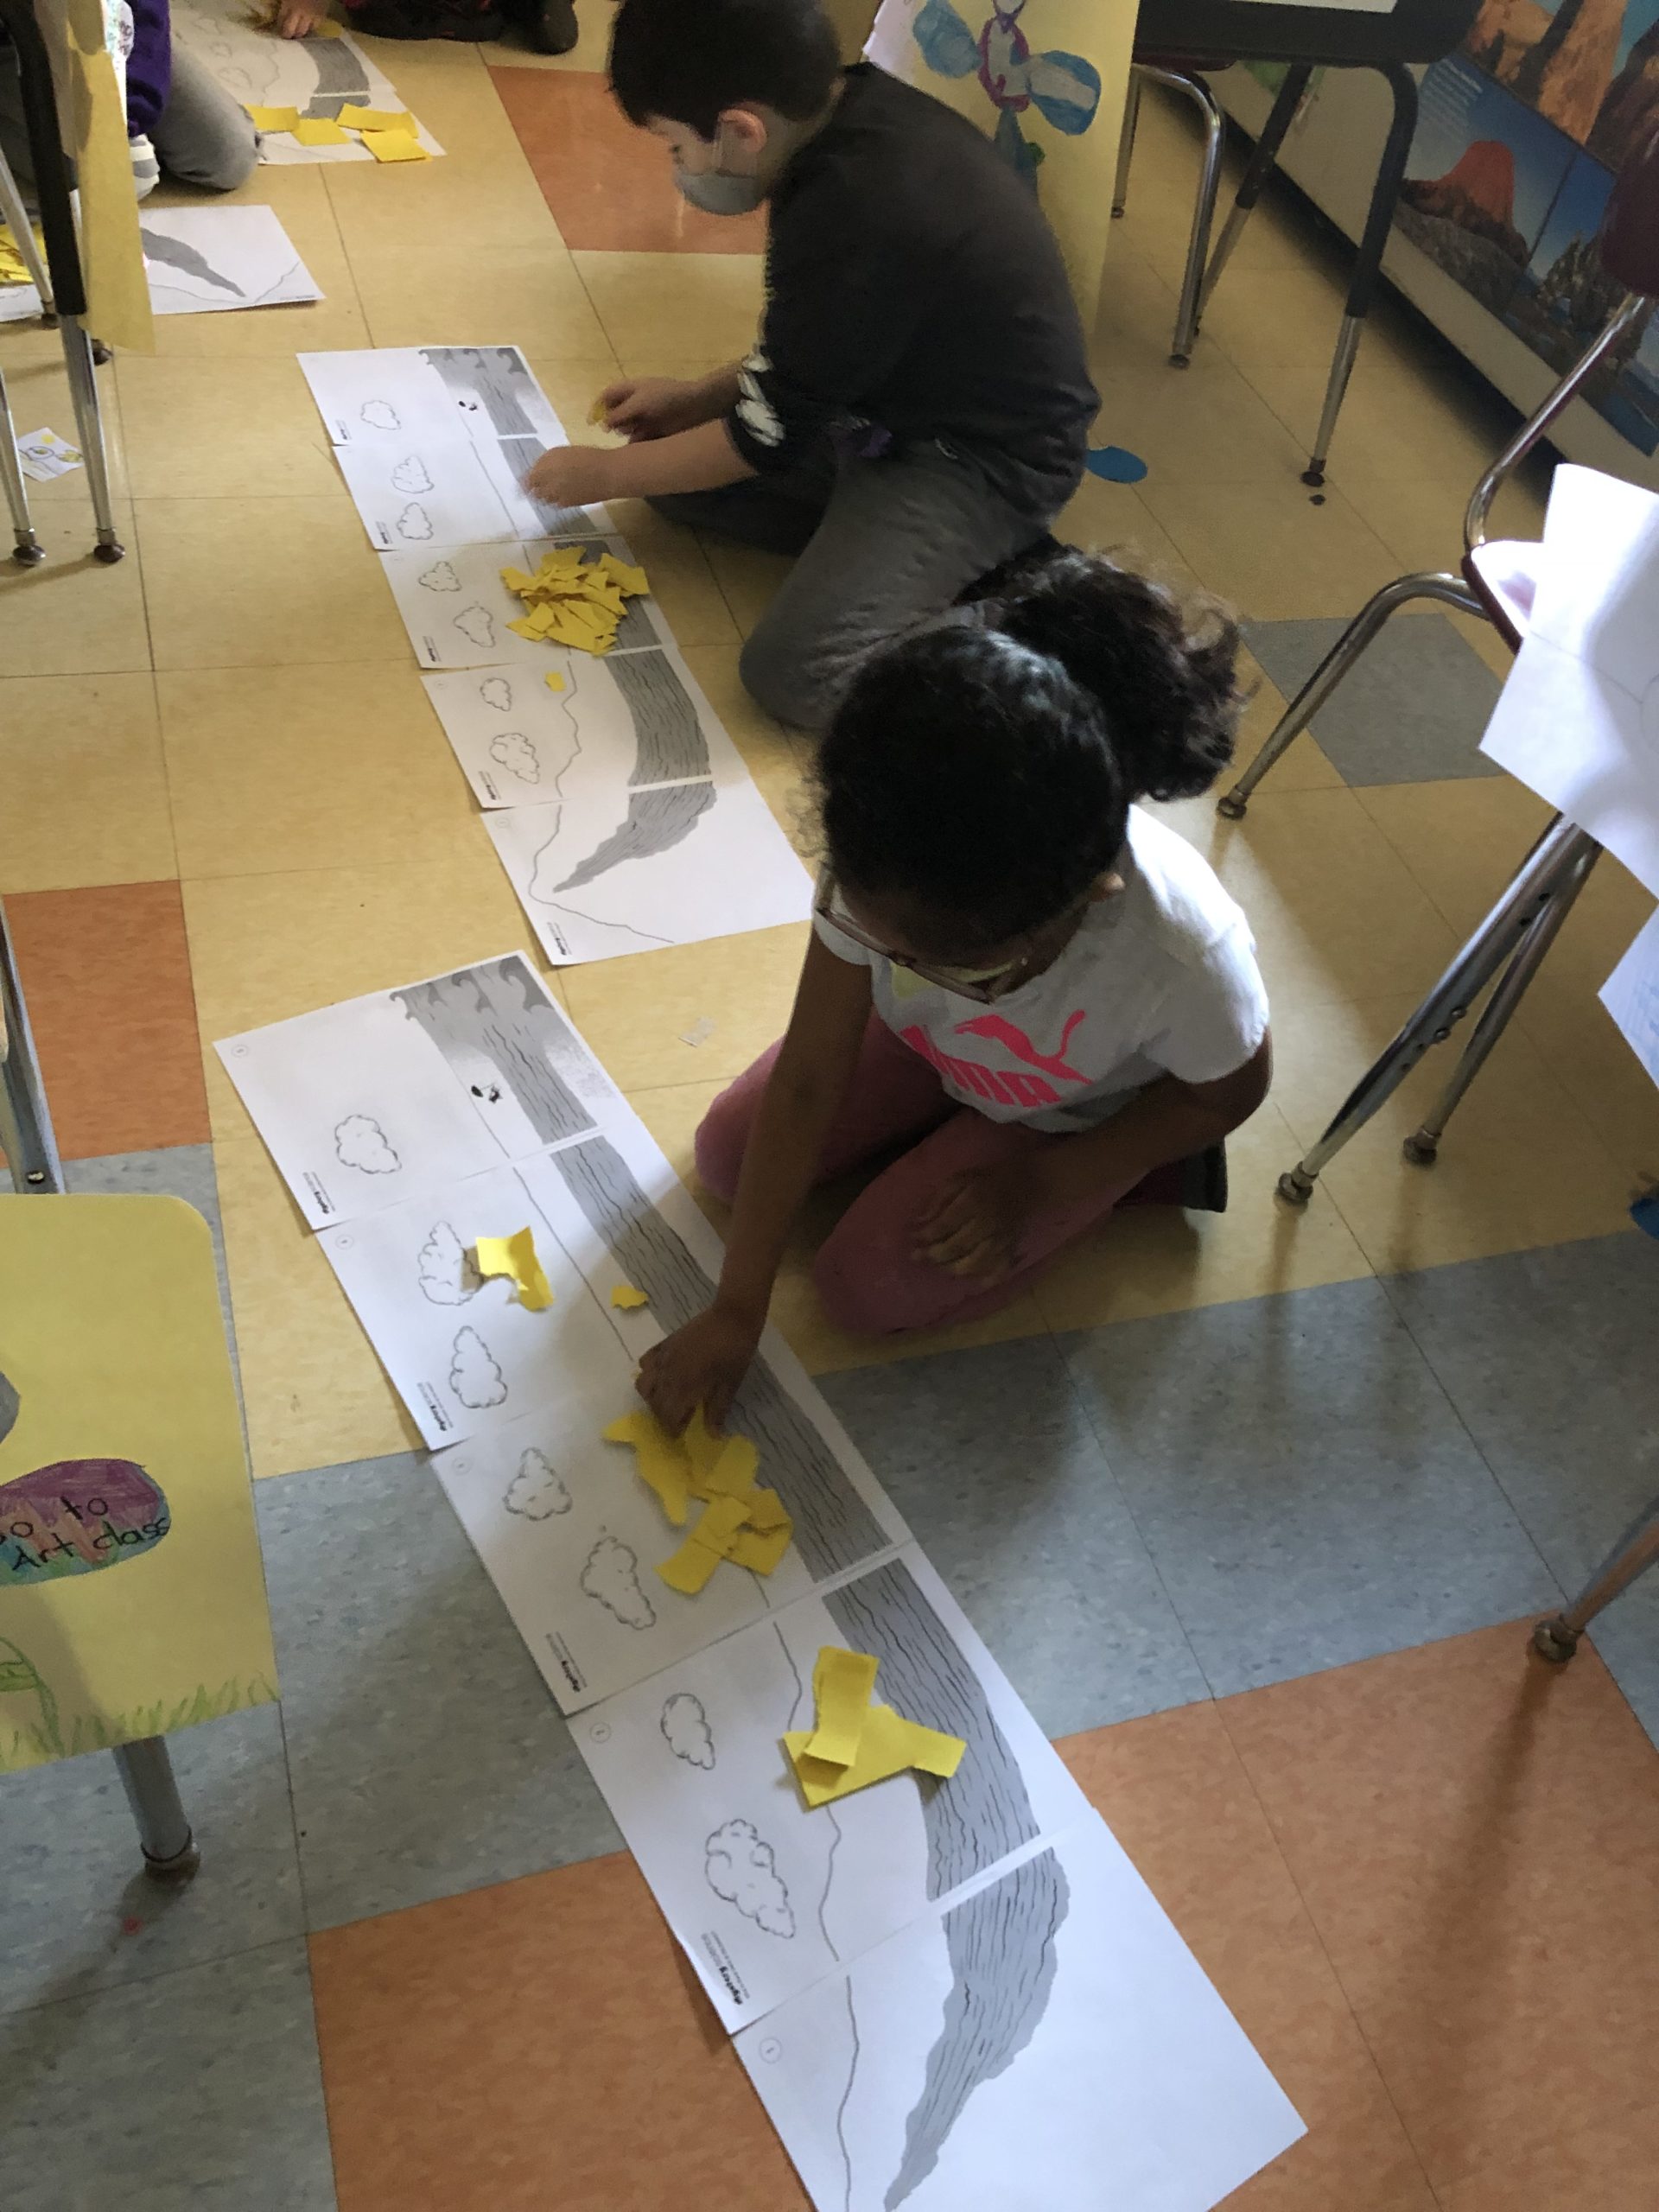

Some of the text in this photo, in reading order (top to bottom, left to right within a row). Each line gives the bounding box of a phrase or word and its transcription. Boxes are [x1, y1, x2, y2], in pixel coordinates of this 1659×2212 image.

[899, 1024, 1062, 1109] MA
[60, 1496, 109, 1521] to
[11, 1516, 169, 1571] Art class
